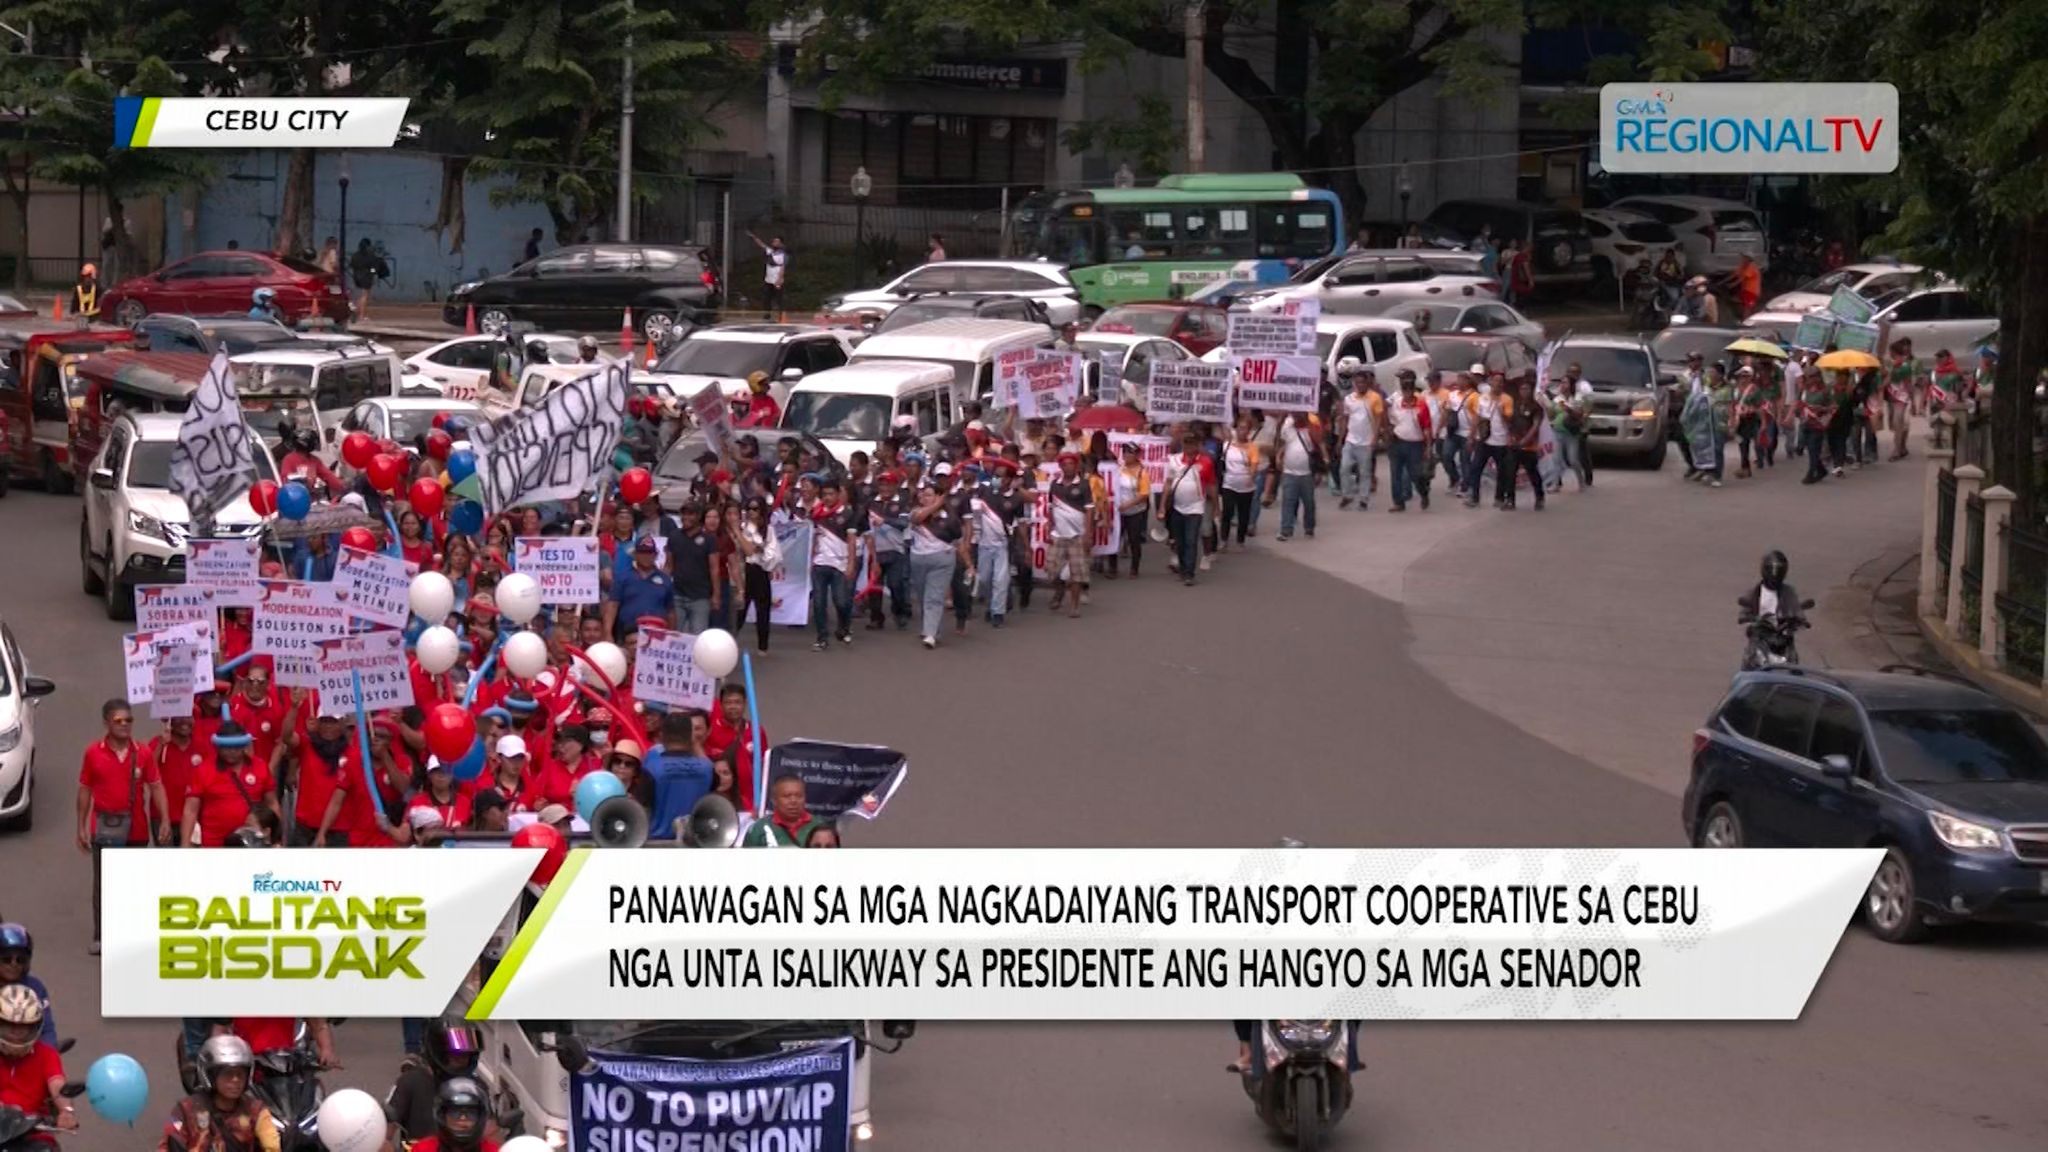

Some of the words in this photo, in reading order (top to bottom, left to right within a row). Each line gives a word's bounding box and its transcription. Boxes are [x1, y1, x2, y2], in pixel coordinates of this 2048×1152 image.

[1243, 358, 1278, 384] CHIZ
[540, 549, 558, 561] YES
[562, 549, 575, 561] TO
[368, 560, 387, 572] PUV
[340, 565, 411, 589] MODERNIZATION
[540, 573, 556, 587] NO
[559, 573, 572, 587] TO
[292, 588, 312, 598] PUV
[352, 579, 390, 597] MUST
[541, 588, 592, 596] PENSION
[149, 596, 179, 606] TAMA
[351, 592, 405, 615] NTINUE
[147, 609, 184, 621] SOBRA
[262, 603, 344, 618] MODERNIZATION
[329, 624, 346, 635] SA
[266, 637, 307, 649] POLUS
[641, 647, 692, 663] MODERNIZA
[322, 655, 401, 673] MODERNIZATION
[656, 661, 693, 678] MUST
[390, 671, 407, 682] SA
[637, 673, 708, 696] CONTINUE
[581, 1082, 635, 1122] NO
[646, 1090, 696, 1126] TO
[707, 1081, 836, 1127] PUVMP
